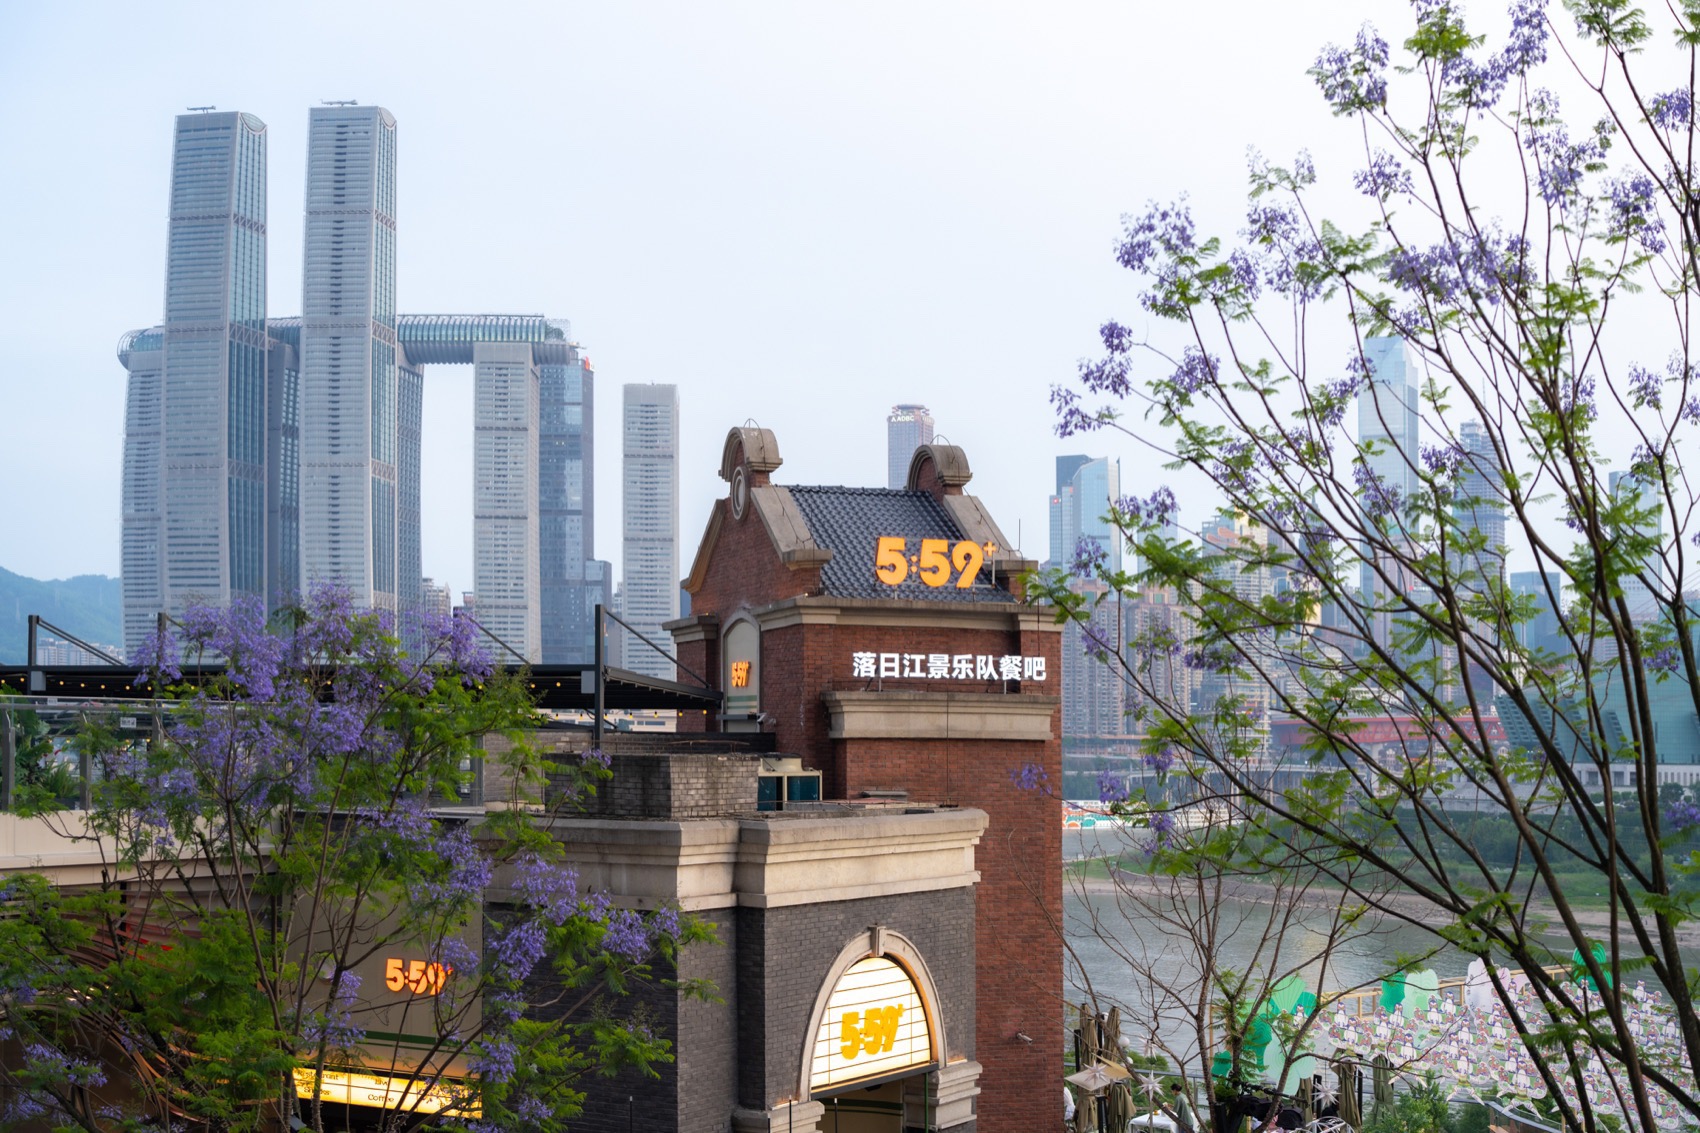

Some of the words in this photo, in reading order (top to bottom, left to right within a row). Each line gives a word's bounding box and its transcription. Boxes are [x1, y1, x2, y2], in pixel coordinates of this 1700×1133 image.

[852, 652, 1047, 681] 落日江景乐队餐吧
[367, 1093, 395, 1103] Coffe
